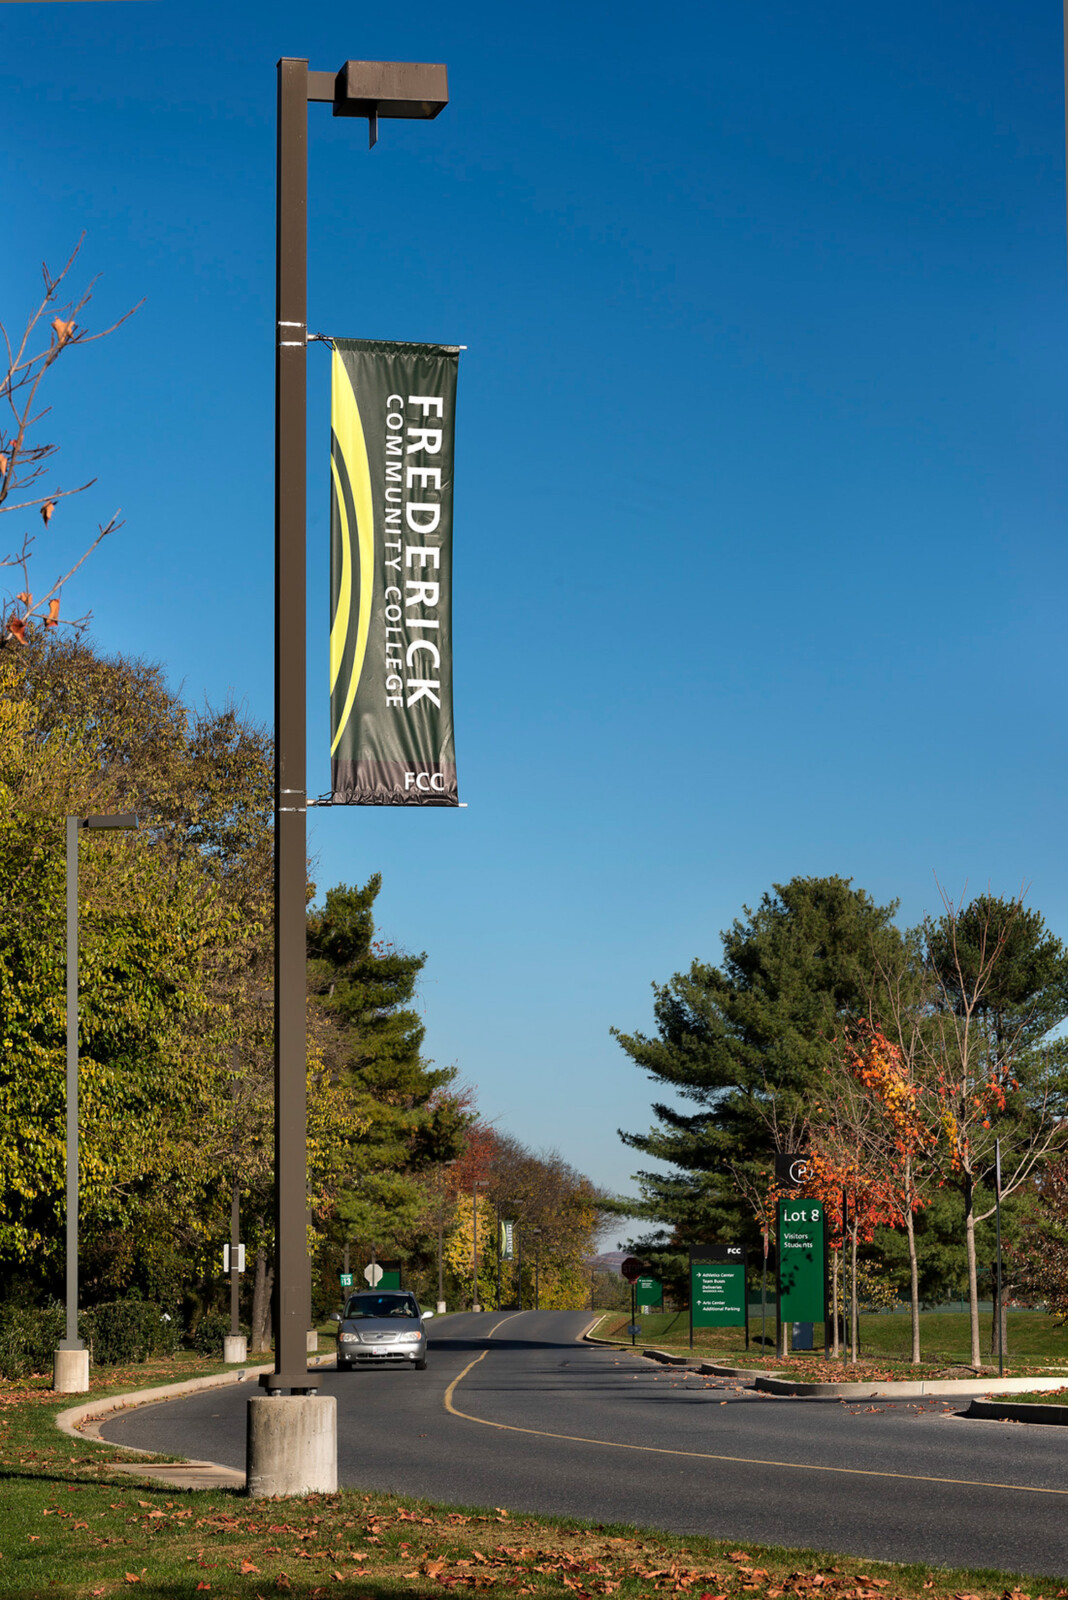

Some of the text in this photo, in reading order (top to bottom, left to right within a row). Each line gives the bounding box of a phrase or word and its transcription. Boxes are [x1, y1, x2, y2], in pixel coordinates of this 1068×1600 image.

[384, 394, 404, 708] COMMUNITY COLLEGE
[405, 395, 444, 710] FREDERICK
[404, 772, 444, 791] FCC
[784, 1209, 820, 1222] Lot 8
[784, 1241, 813, 1249] Students
